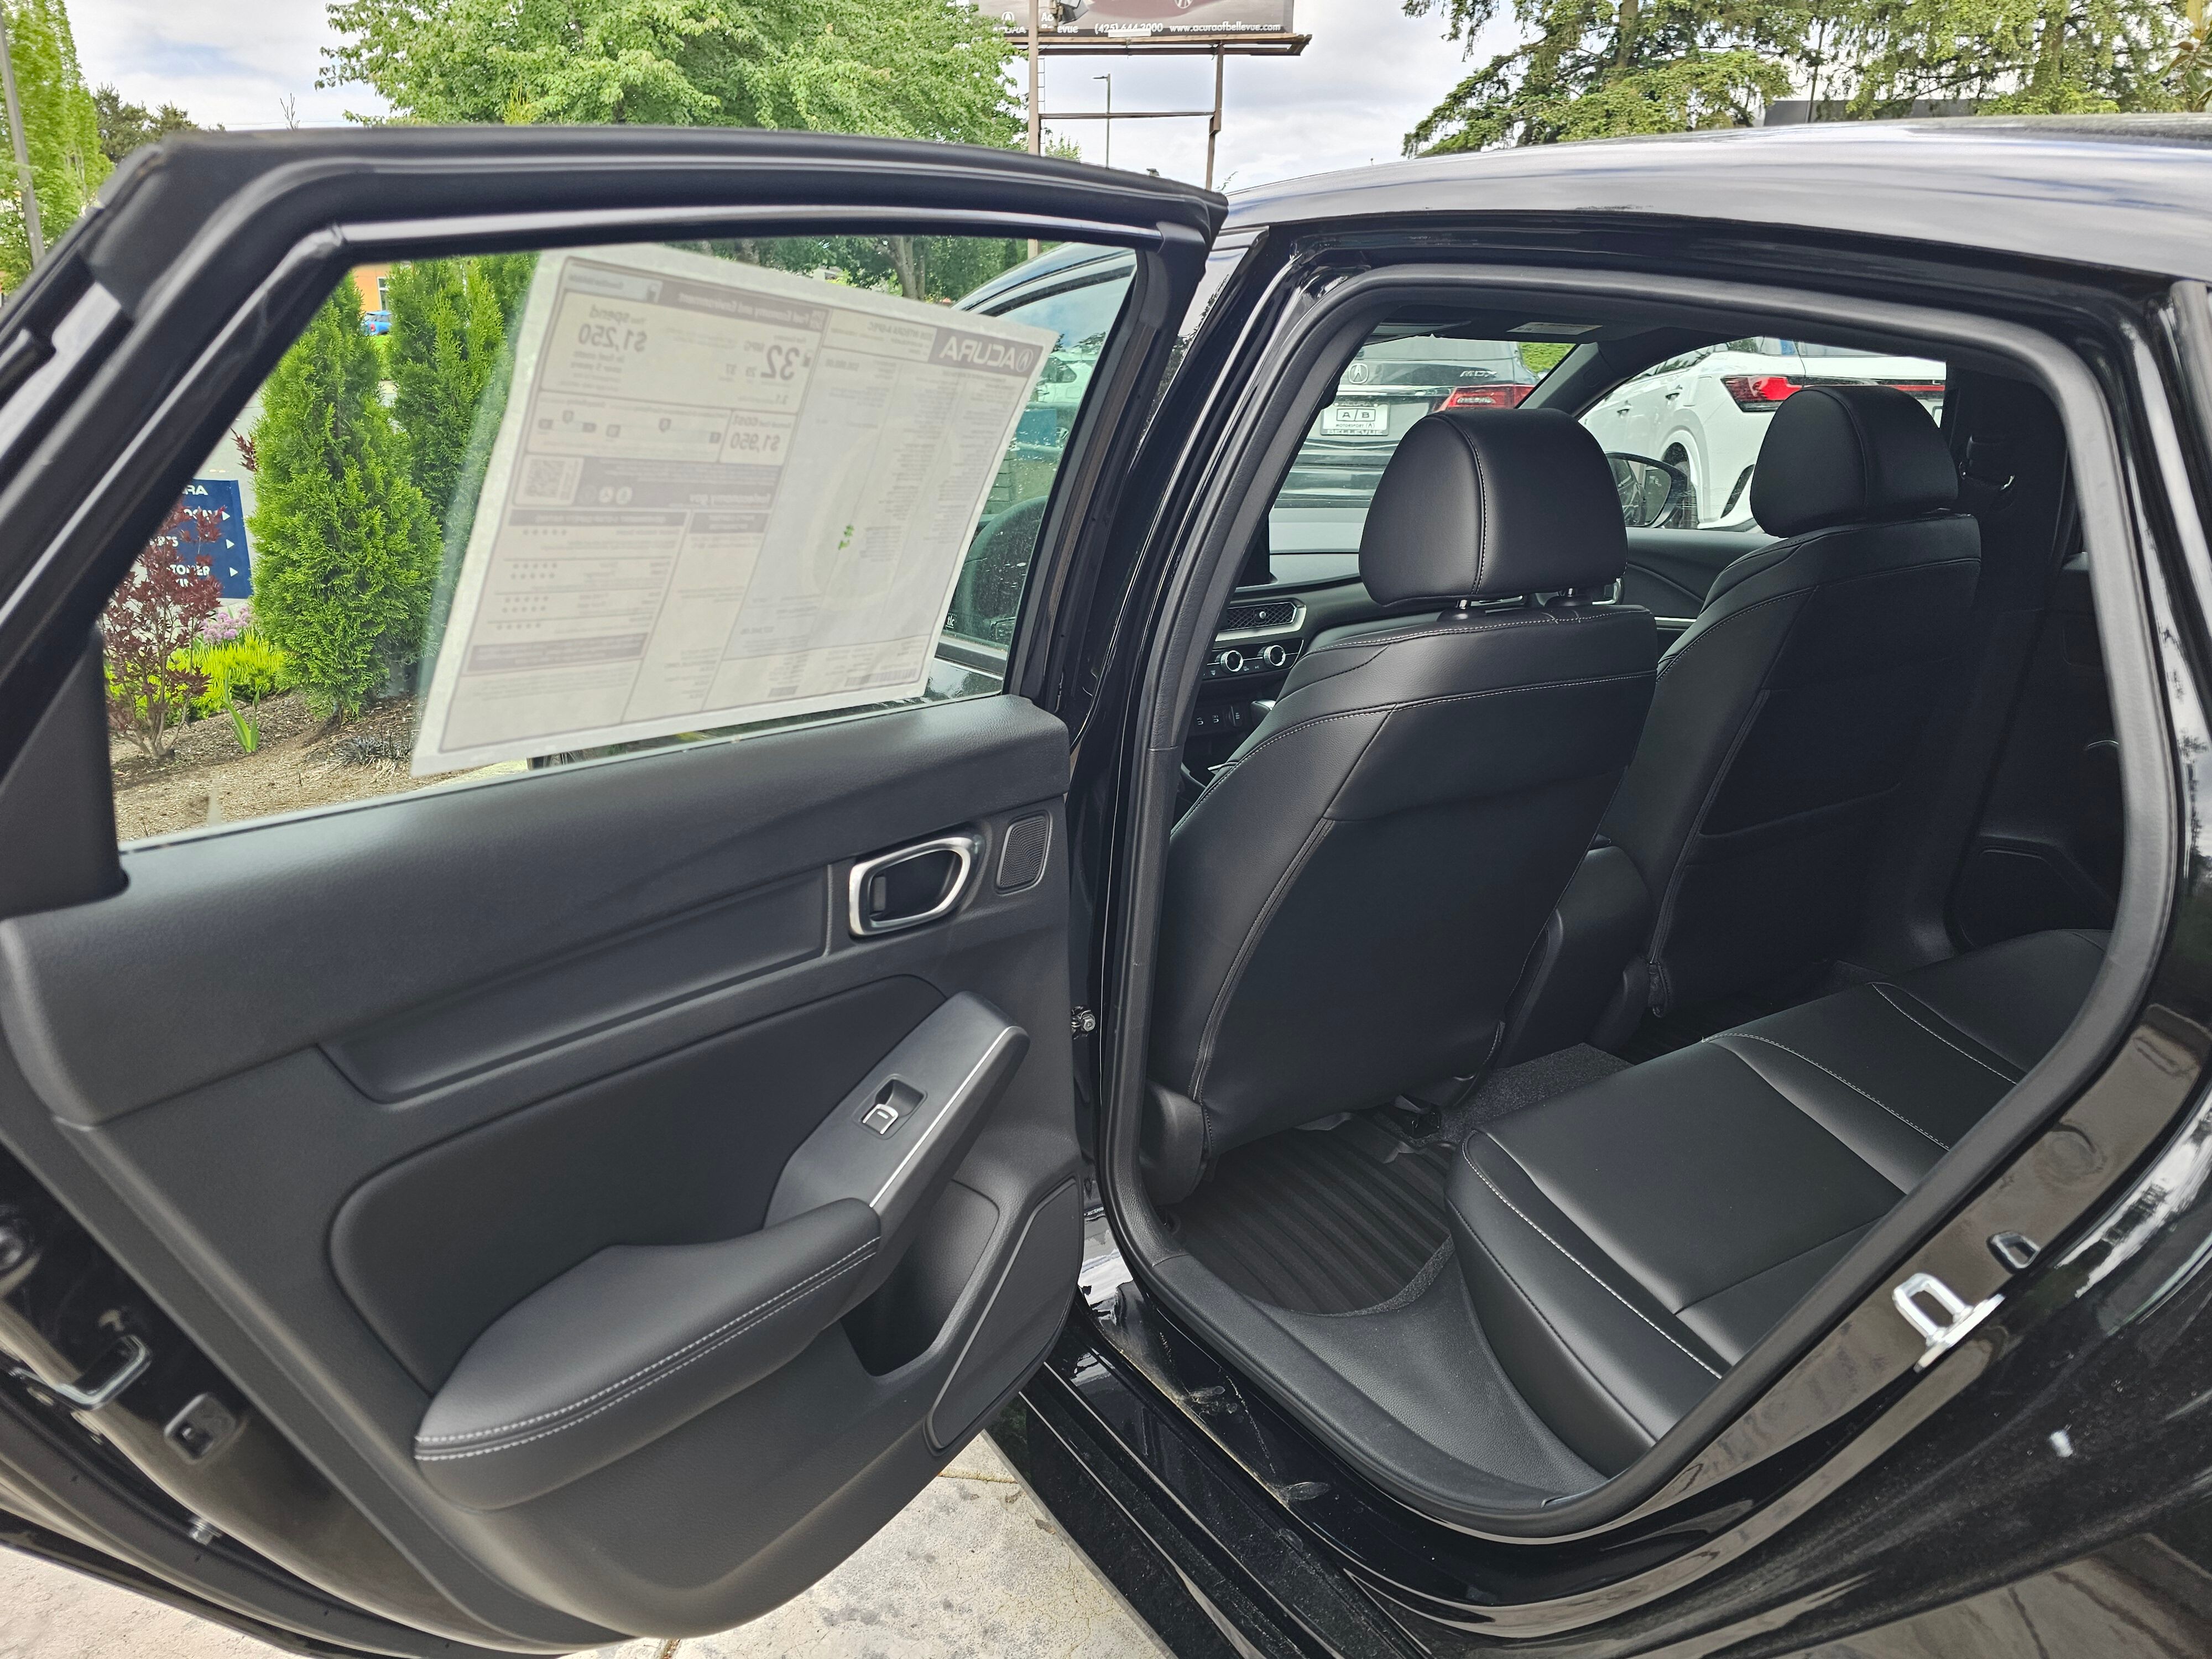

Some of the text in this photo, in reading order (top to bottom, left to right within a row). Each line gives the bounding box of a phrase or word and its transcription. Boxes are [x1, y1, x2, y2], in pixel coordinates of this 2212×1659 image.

[1169, 21, 1281, 32] www.acuraofbellevue.com
[1460, 370, 1499, 378] MDX
[182, 485, 208, 495] RA
[947, 615, 955, 627] tlc
